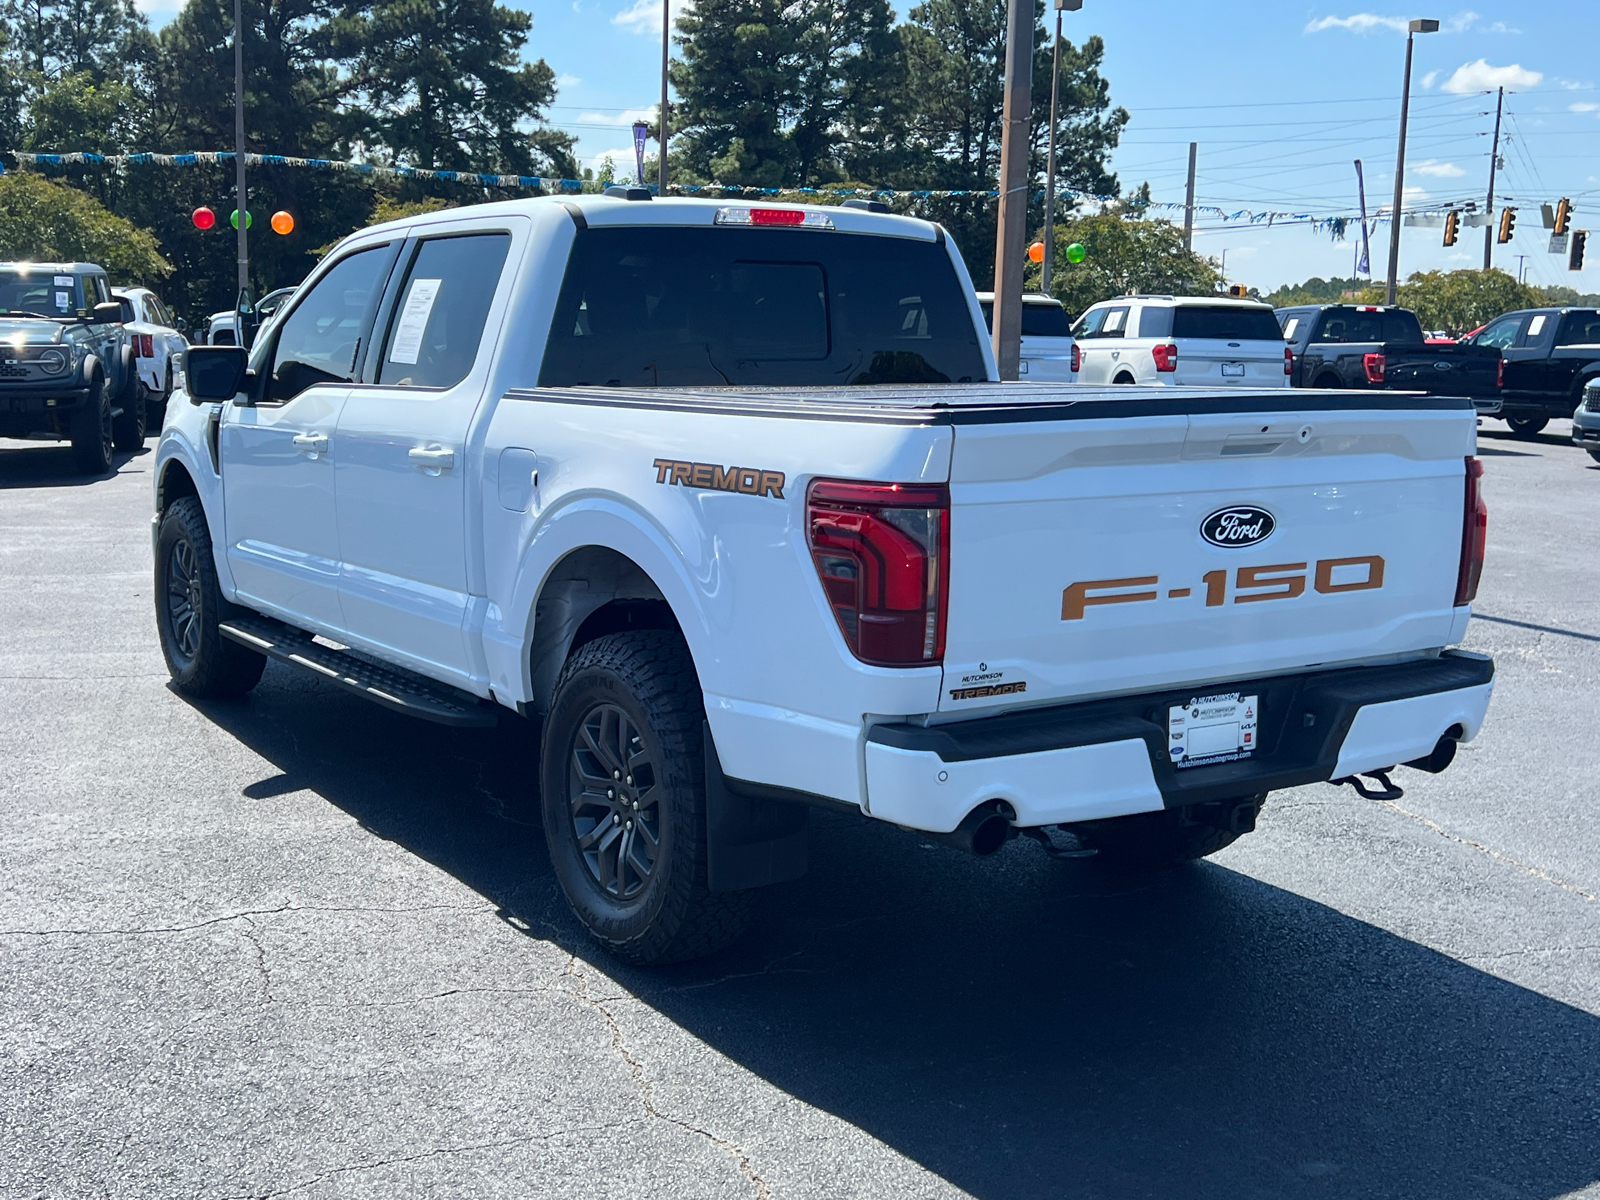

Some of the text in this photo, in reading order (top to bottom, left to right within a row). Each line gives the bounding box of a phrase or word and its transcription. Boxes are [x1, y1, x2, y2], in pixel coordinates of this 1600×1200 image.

[653, 458, 785, 499] TREMOR
[1215, 512, 1263, 541] Ford
[1061, 555, 1385, 620] F-150
[962, 672, 1003, 682] HUTCHINSON
[950, 681, 1026, 700] TREMOR
[1177, 752, 1251, 768] Hutchinsonautogroup.com
